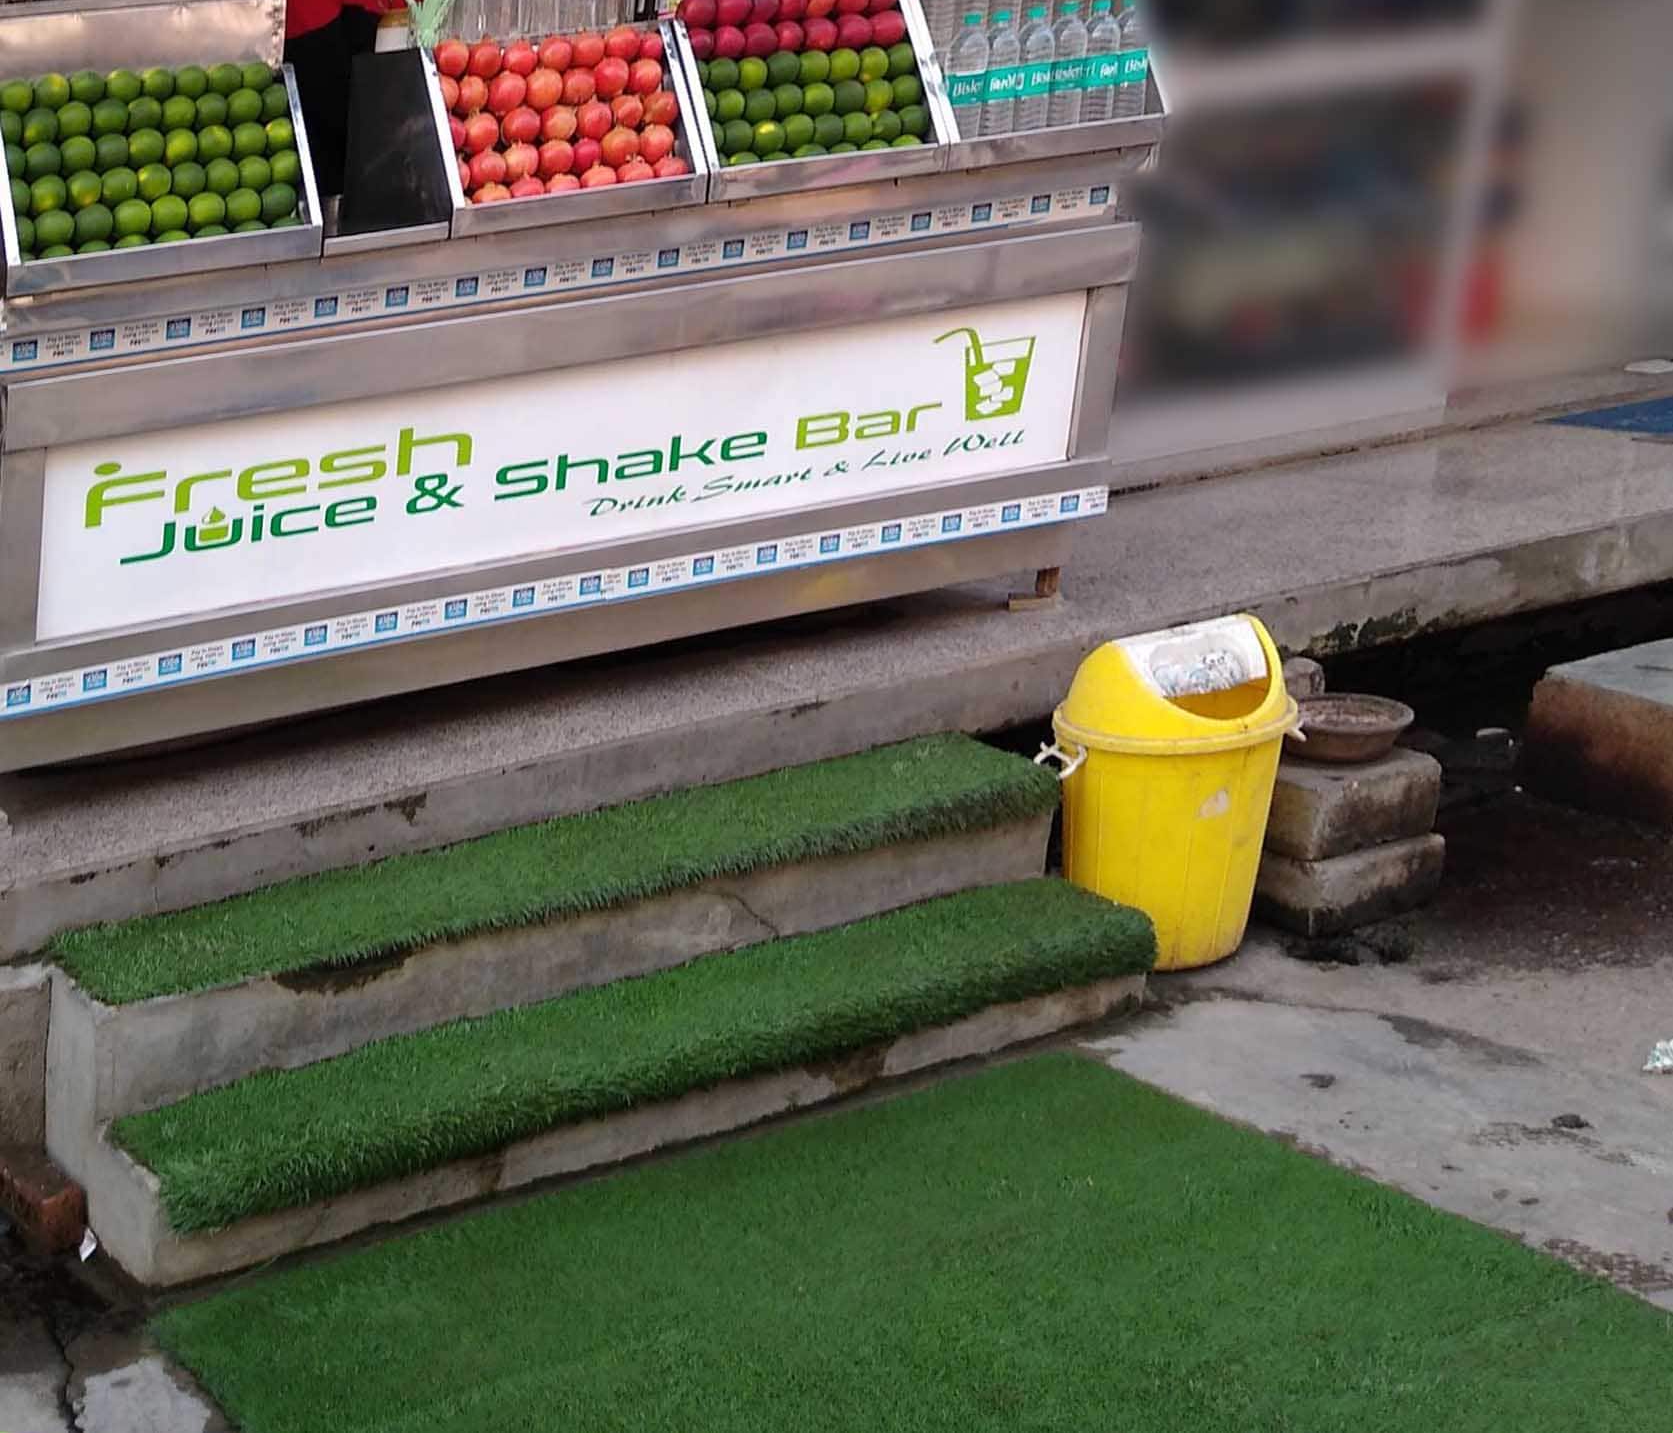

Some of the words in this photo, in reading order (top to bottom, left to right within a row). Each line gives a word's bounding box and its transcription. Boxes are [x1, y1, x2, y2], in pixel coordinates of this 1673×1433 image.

[84, 427, 474, 530] Fresh
[118, 496, 378, 565] Juice
[406, 472, 463, 515] &
[494, 429, 768, 502] Shake
[794, 401, 943, 451] Bar
[587, 484, 688, 518] Drink
[689, 466, 812, 504] Smart
[823, 460, 850, 477] &
[862, 447, 933, 471] Live
[943, 429, 1026, 457] Well
